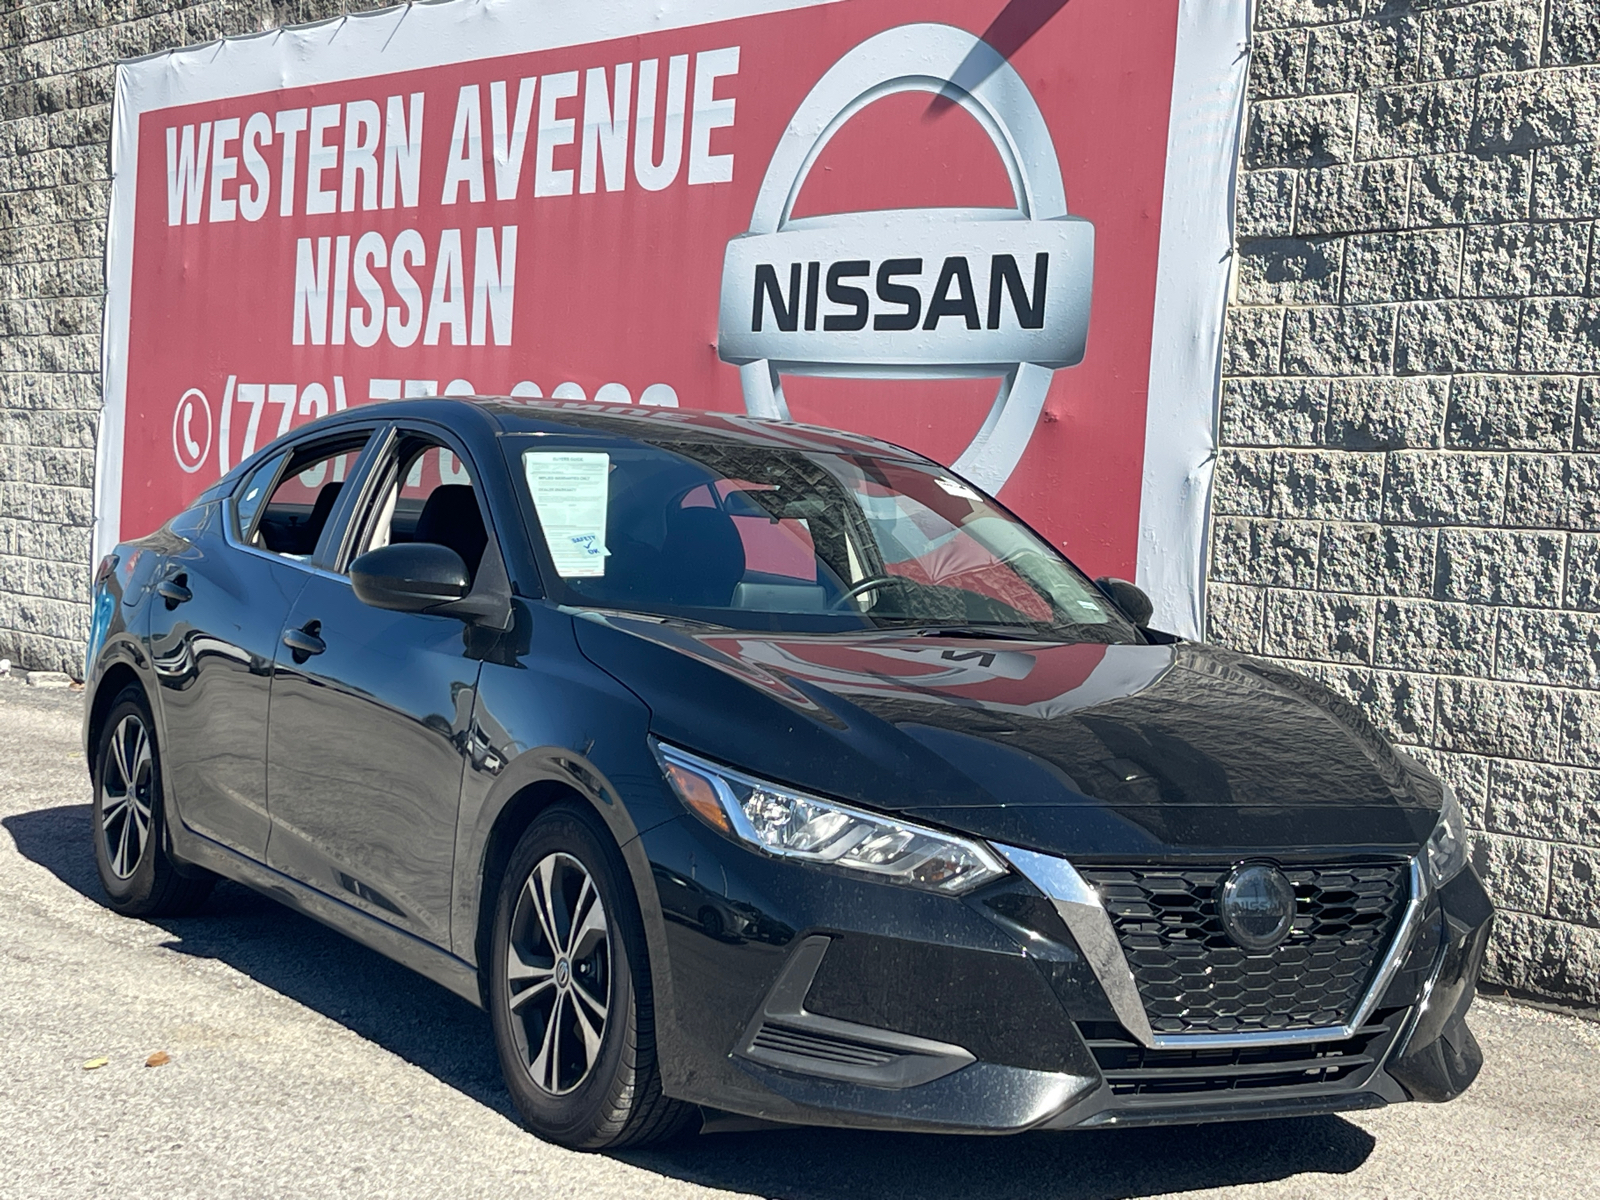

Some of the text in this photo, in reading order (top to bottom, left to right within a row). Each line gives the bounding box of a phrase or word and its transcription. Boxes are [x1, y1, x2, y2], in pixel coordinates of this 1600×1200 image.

[165, 46, 741, 226] WESTERN AVENUE
[292, 225, 518, 348] NISSAN
[751, 252, 1049, 332] NISSAN
[571, 535, 596, 543] SAFETY
[1230, 901, 1289, 915] NISSAN
